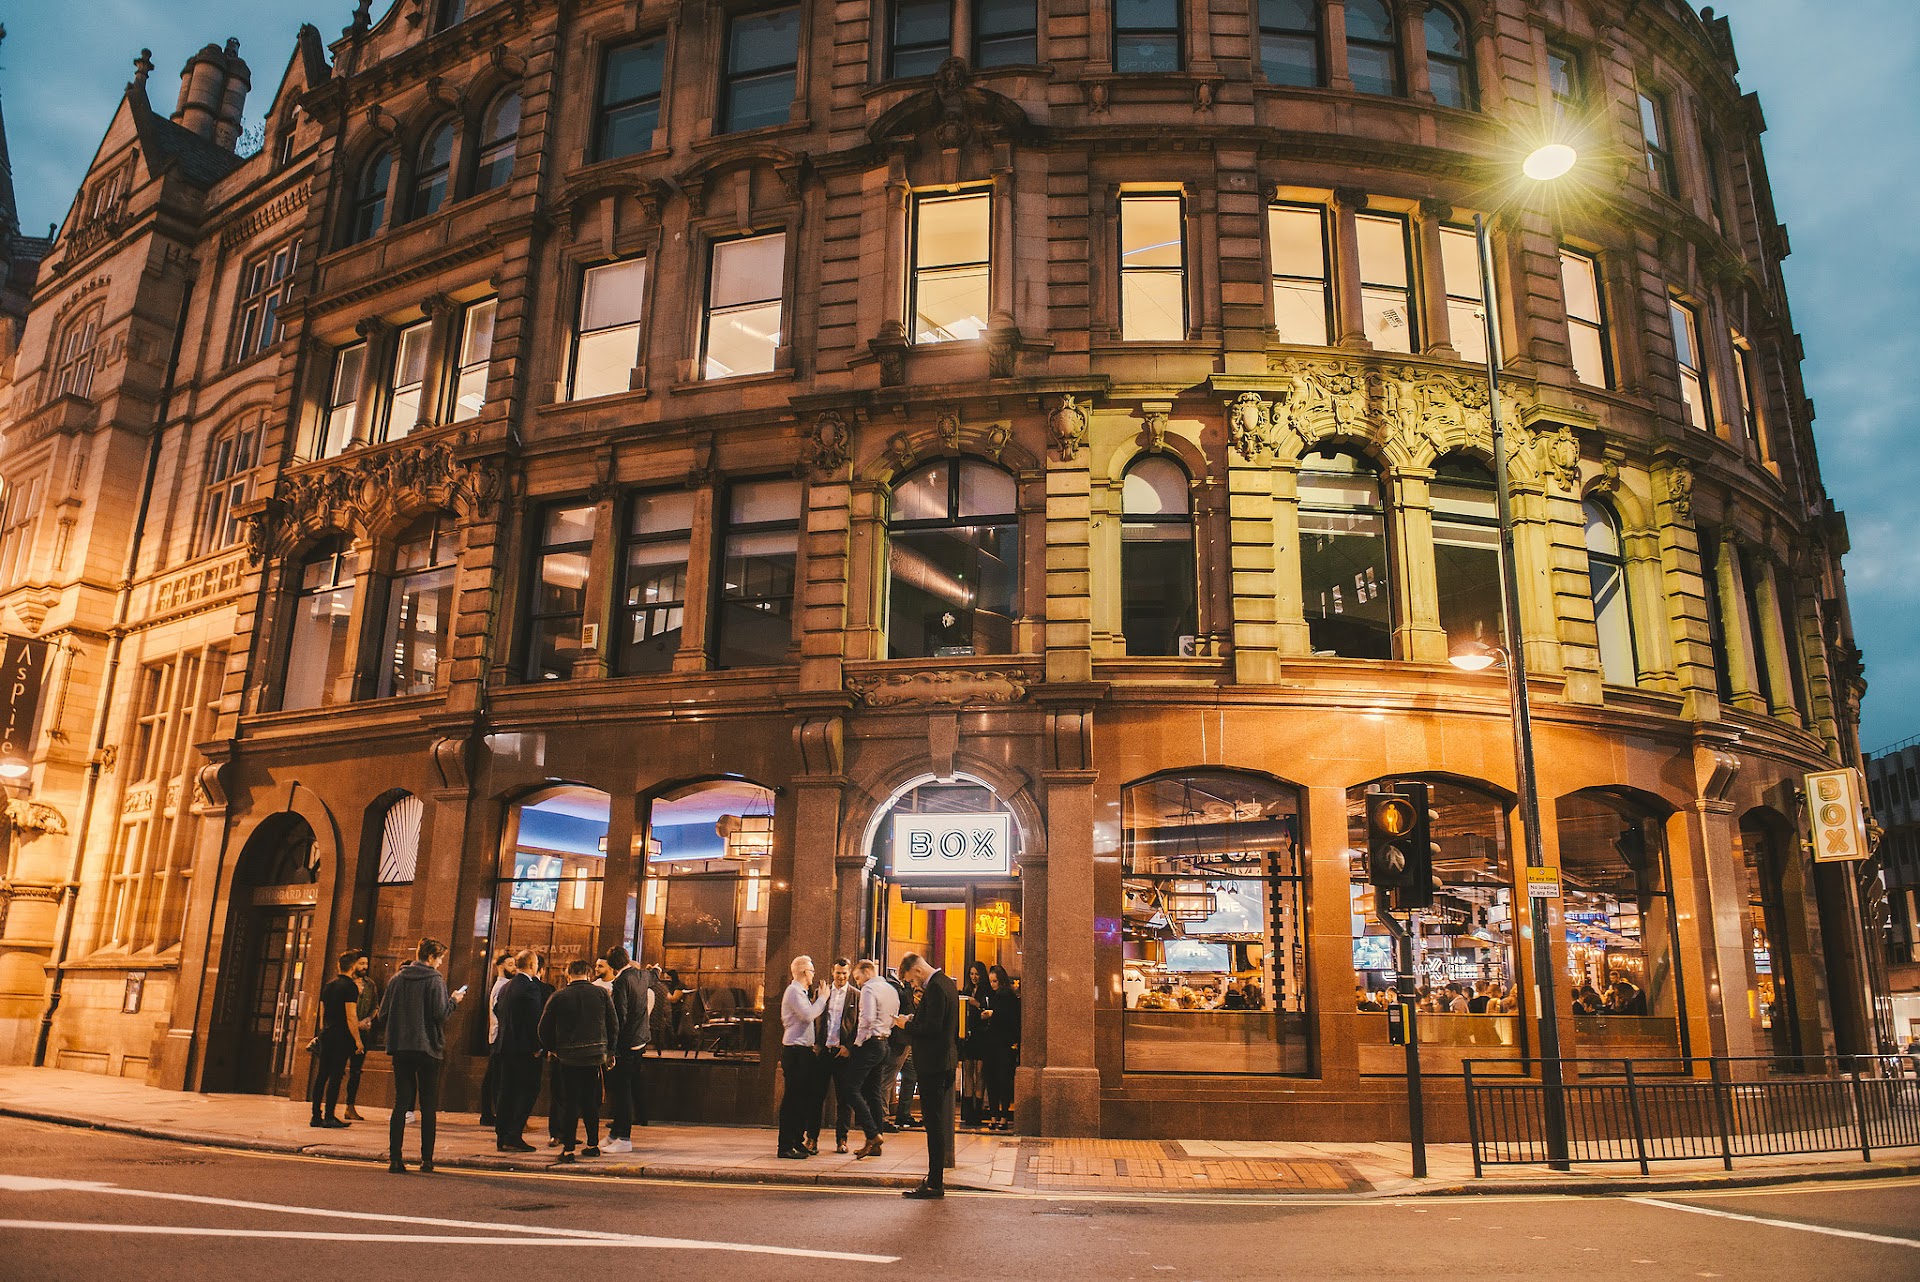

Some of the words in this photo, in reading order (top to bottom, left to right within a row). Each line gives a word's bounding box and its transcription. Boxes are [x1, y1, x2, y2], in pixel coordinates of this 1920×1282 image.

[0, 643, 33, 754] Aspire
[908, 828, 998, 861] BOX
[1817, 777, 1850, 854] BOX
